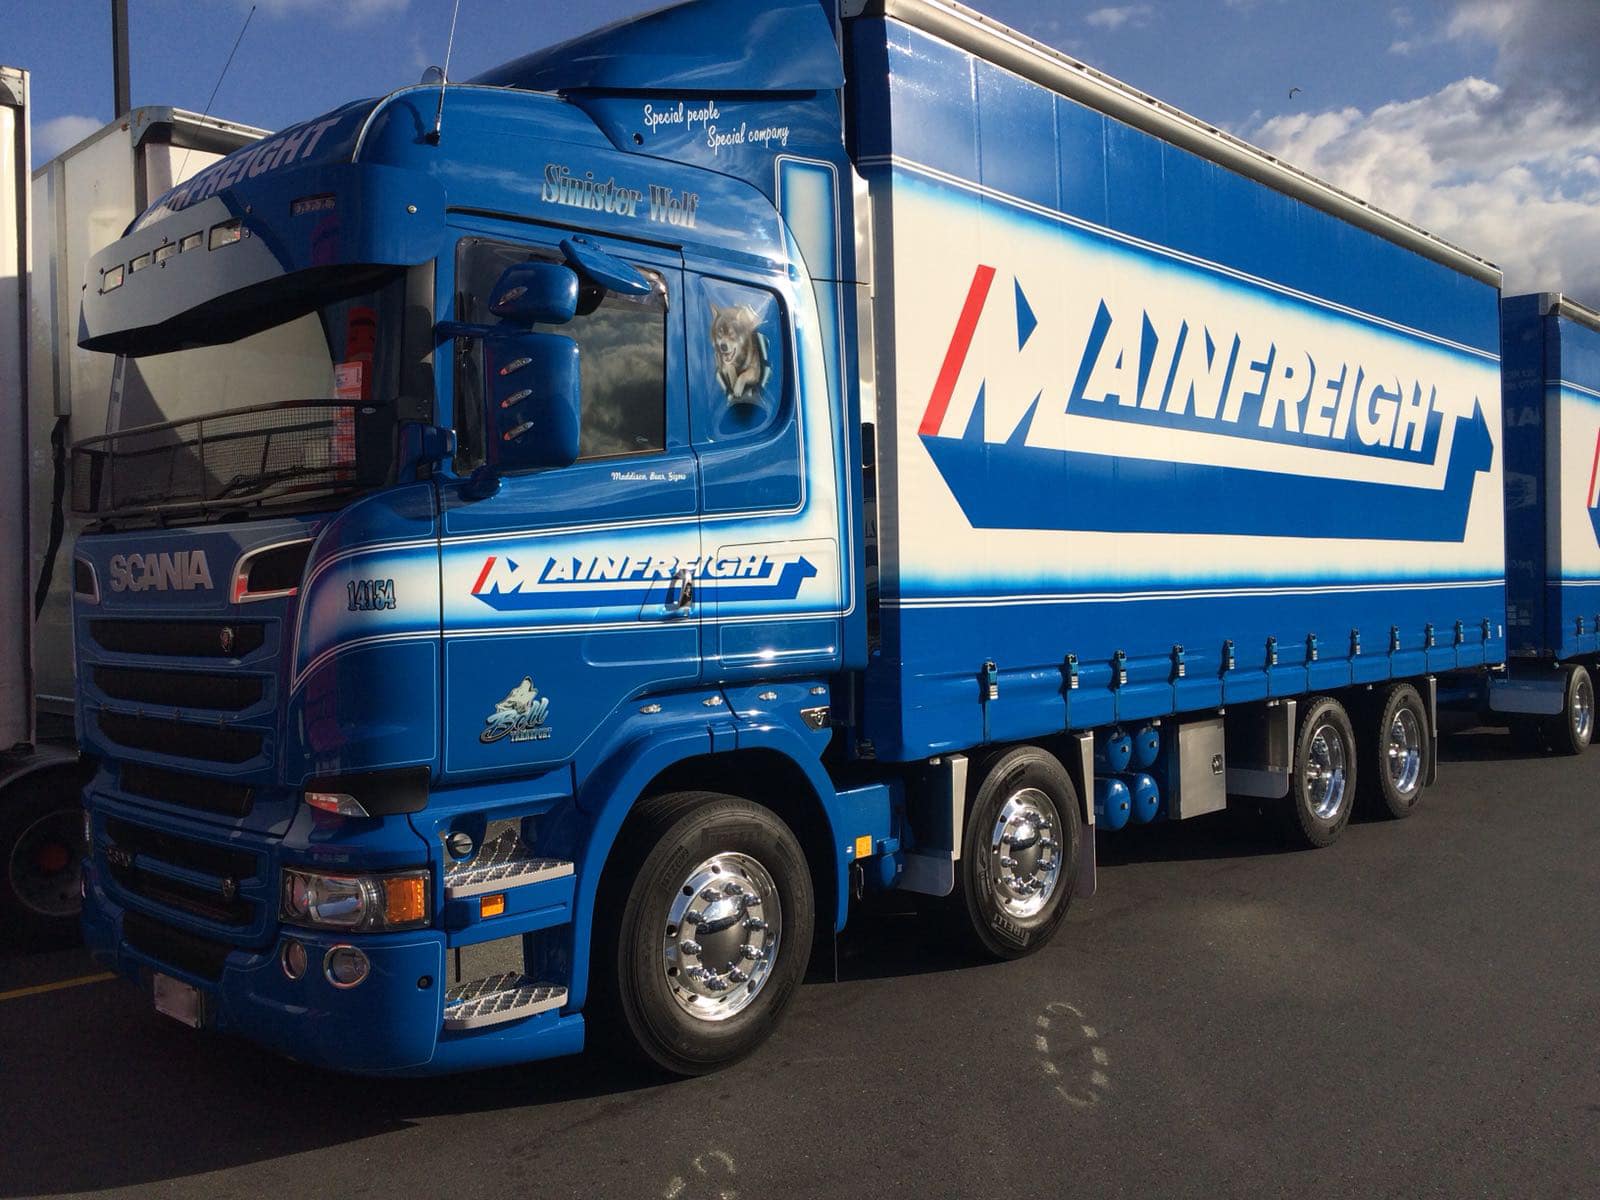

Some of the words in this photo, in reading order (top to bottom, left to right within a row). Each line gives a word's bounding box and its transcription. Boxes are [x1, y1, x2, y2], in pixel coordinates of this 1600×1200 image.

[643, 101, 684, 134] Special
[687, 100, 720, 131] people
[706, 122, 746, 155] Special
[748, 126, 789, 148] company
[541, 163, 643, 218] Sinister
[649, 184, 699, 229] Wolf
[918, 264, 1486, 500] MAINFREIGHT
[110, 550, 214, 592] SCANIA
[471, 553, 806, 600] MAINFREIGHT
[346, 578, 397, 612] 14154
